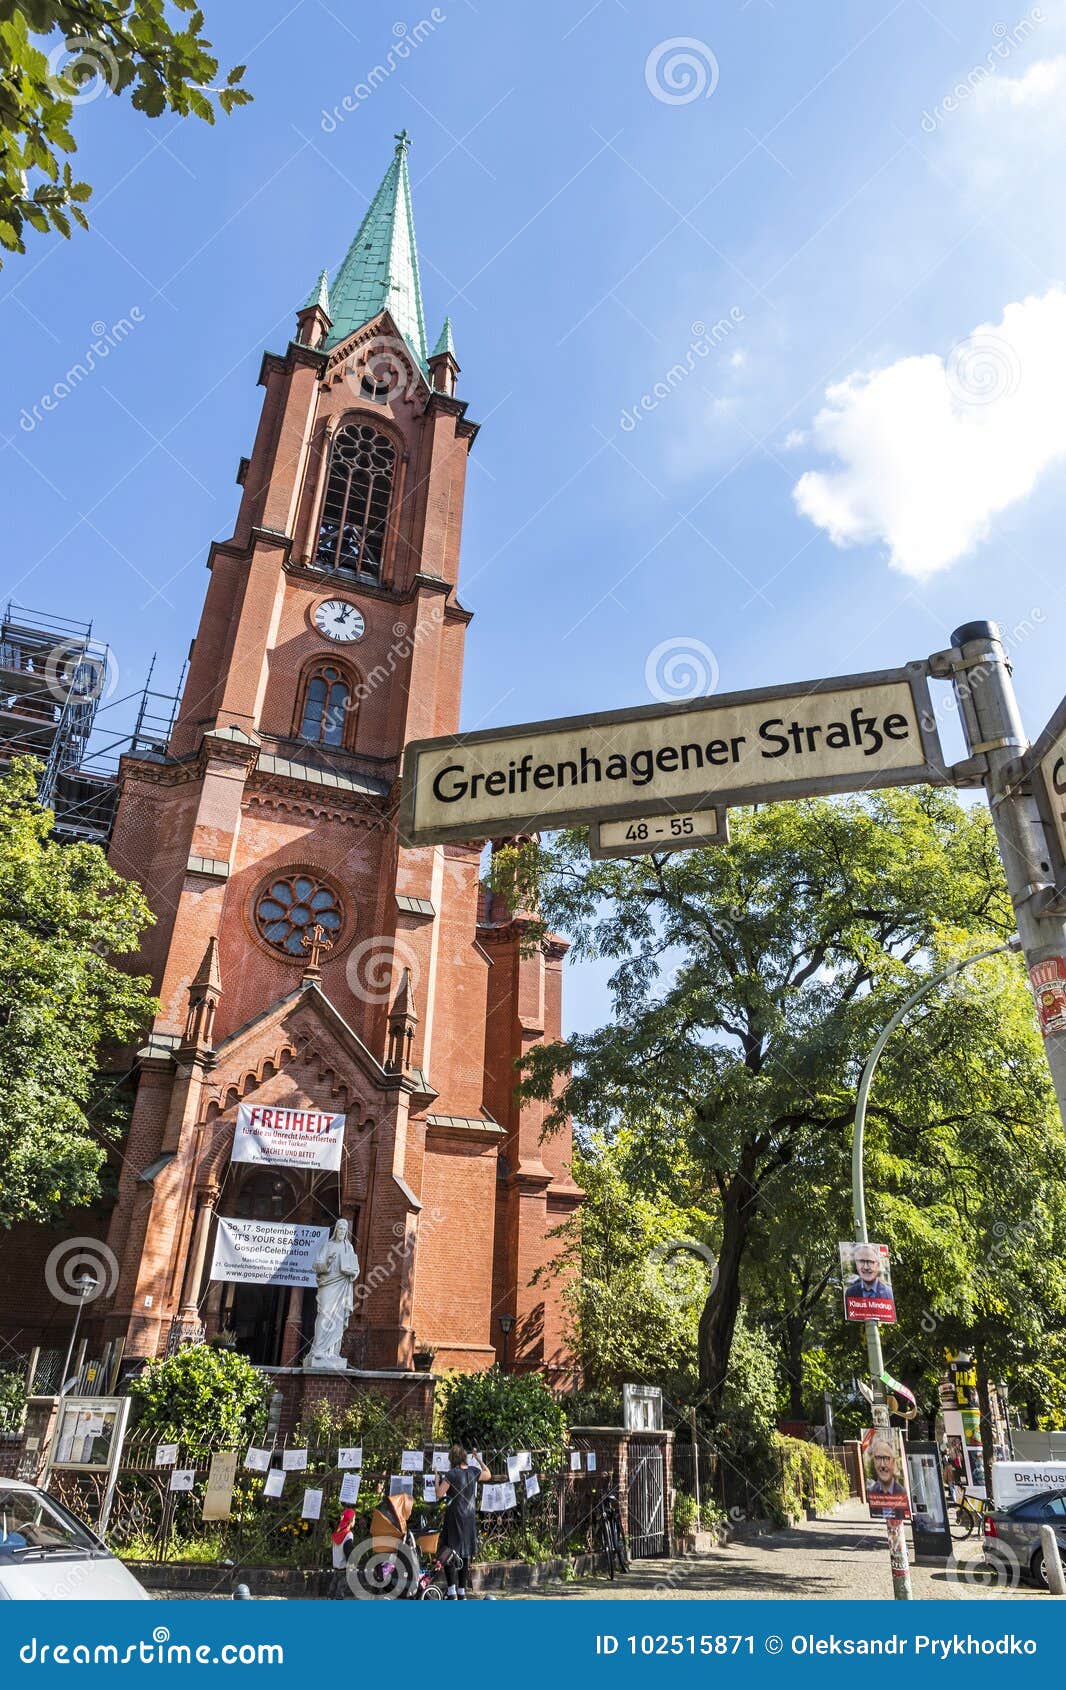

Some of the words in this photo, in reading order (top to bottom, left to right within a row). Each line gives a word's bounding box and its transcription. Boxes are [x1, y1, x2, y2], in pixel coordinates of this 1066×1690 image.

[432, 736, 746, 803] Greifenhagener
[758, 707, 909, 758] Straße
[625, 823, 649, 841] 48
[670, 817, 694, 836] 55
[249, 1107, 334, 1134] FREIHEIT
[253, 1128, 262, 1136] die
[272, 1130, 298, 1140] Unrecht
[260, 1146, 284, 1155] WACHET
[285, 1149, 297, 1157] UND
[298, 1151, 316, 1159] BETET
[227, 1222, 240, 1232] So,
[242, 1224, 254, 1232] 17.
[255, 1226, 299, 1236] September,
[301, 1229, 321, 1238] 17:00
[252, 1235, 276, 1244] YOUR
[234, 1243, 309, 1257] Gospel-Celebration
[225, 1271, 310, 1282] www.gospelchortreffen.de
[869, 1301, 892, 1311] Mindrup
[1014, 1473, 1066, 1483] DR.HOUS
